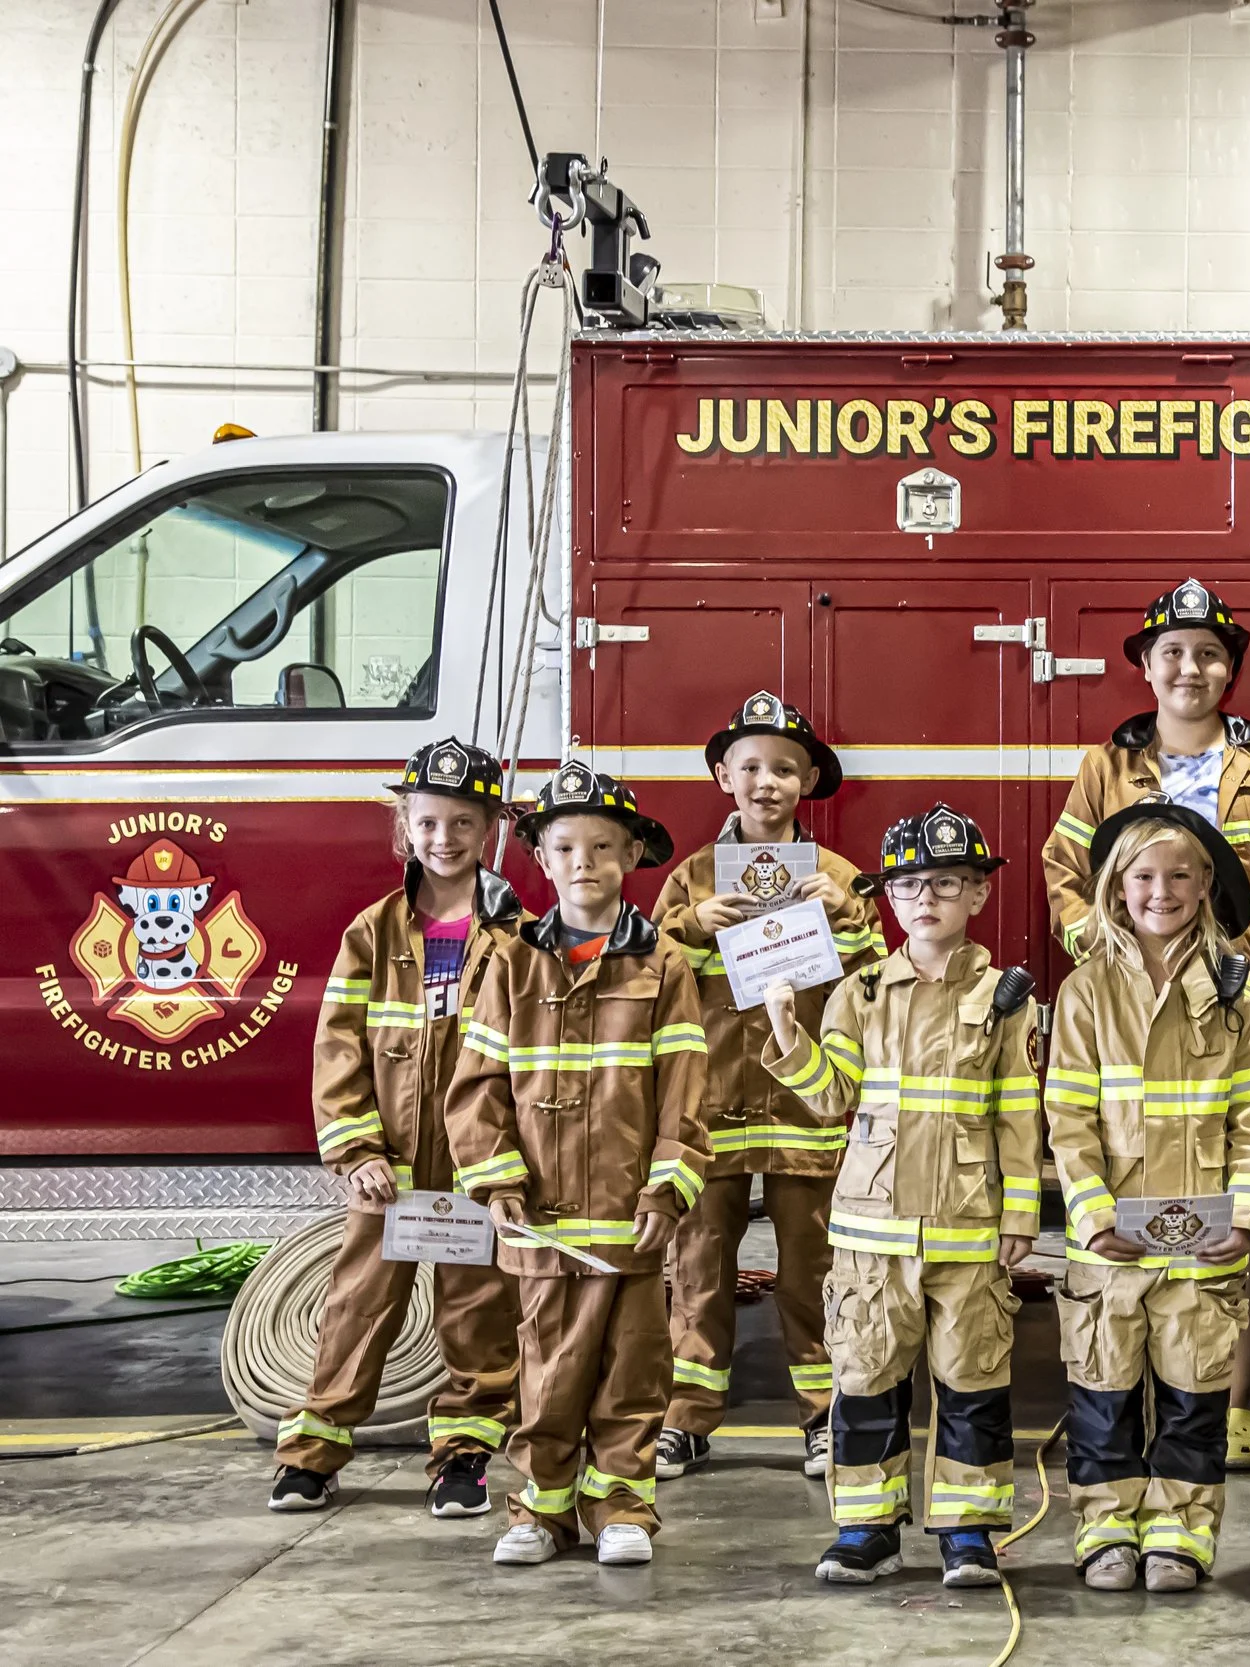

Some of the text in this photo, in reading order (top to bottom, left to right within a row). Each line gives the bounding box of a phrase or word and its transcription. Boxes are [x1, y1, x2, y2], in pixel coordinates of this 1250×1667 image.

[676, 397, 993, 456] JUNIOR'S
[924, 534, 933, 550] 1
[107, 811, 228, 844] JUNIOR'S
[35, 960, 299, 1070] FIREFIGHTER CHALLENGE
